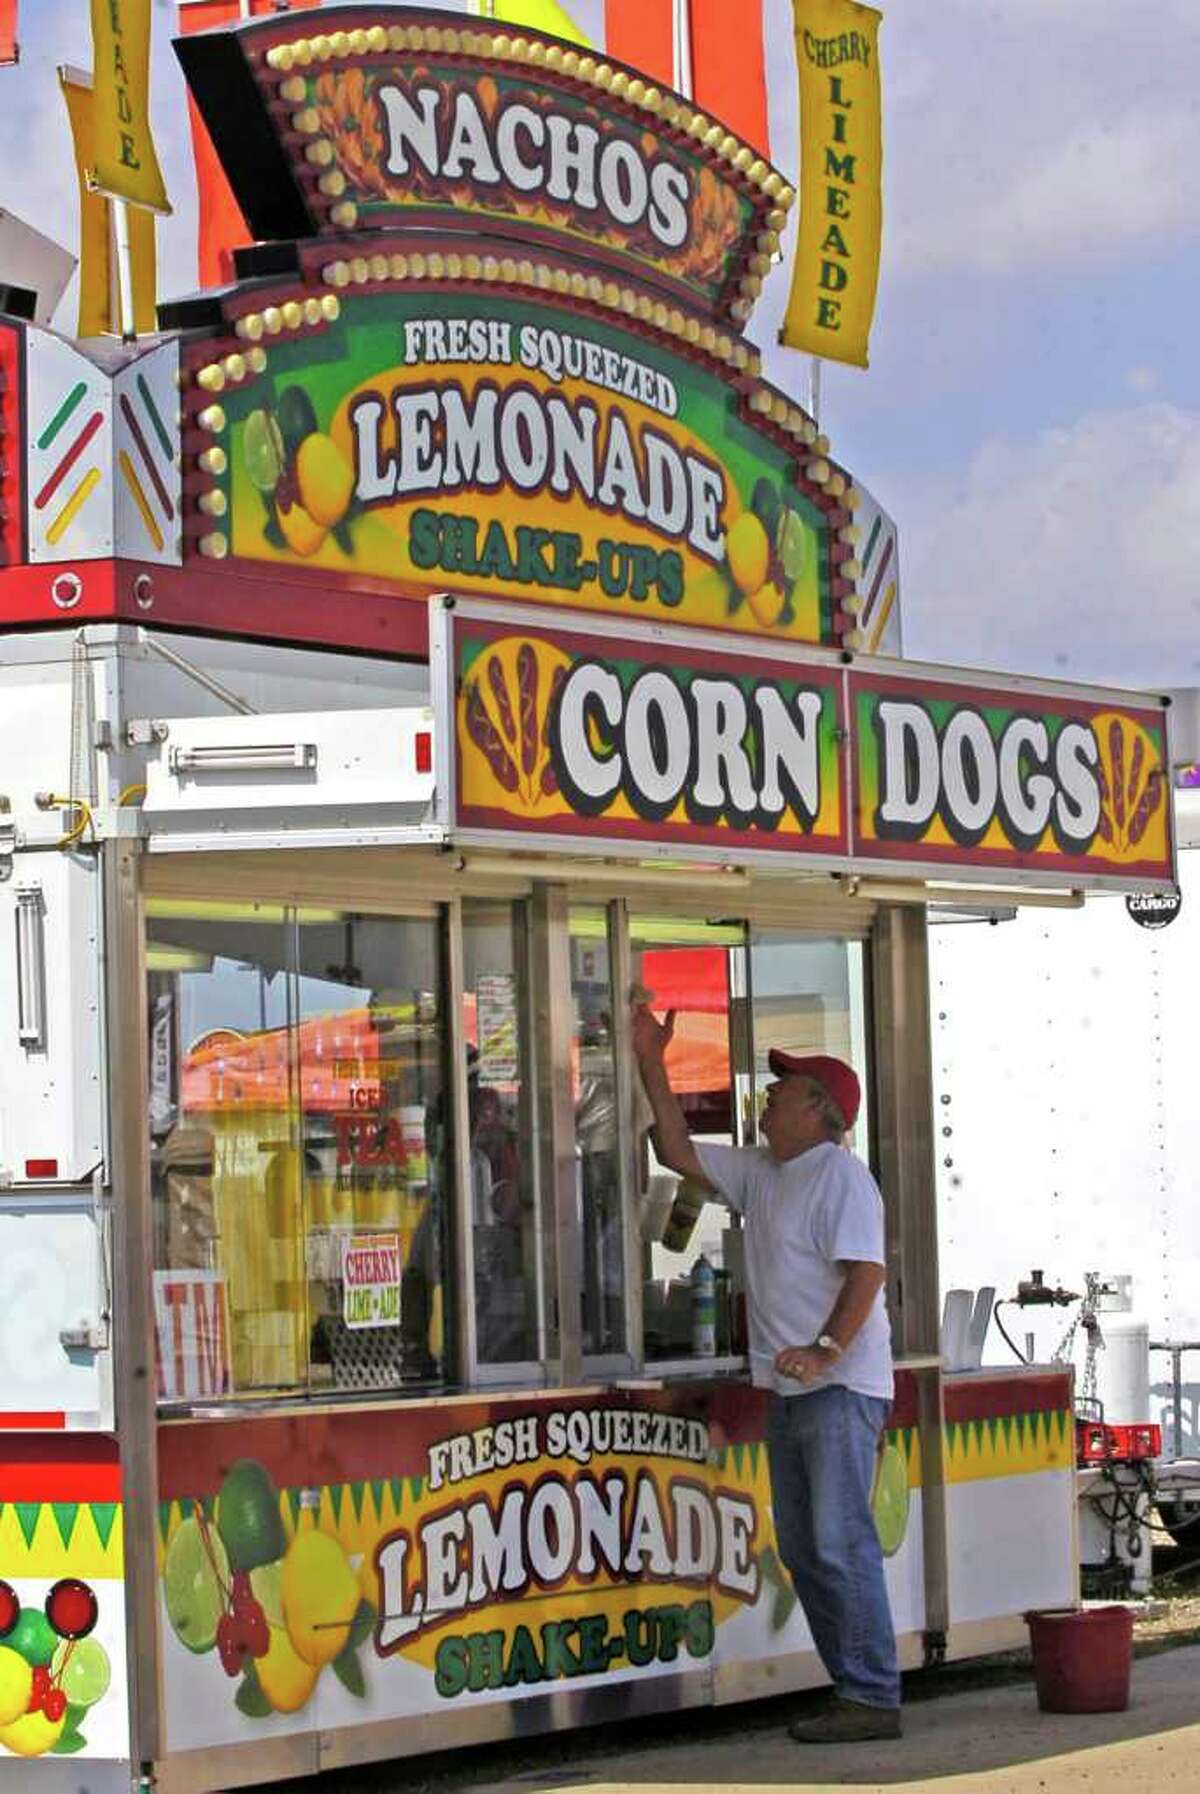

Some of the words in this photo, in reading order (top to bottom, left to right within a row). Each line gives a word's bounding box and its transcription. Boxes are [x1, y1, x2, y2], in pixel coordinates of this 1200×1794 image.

[803, 29, 870, 68] CHERRY
[379, 85, 689, 248] NACHOS
[816, 75, 856, 331] LIMEADE
[403, 319, 512, 364] FRESH
[519, 324, 678, 418] SQUEEZED
[351, 388, 727, 562] LEMONADE
[409, 509, 685, 606] SHAKE-UPS
[557, 661, 824, 823] CORN
[877, 701, 1102, 841] DOGS
[345, 1249, 399, 1285] CHERRY
[427, 1418, 538, 1490] FRESH
[547, 1410, 710, 1462] SQUEEZED
[378, 1476, 759, 1648] LEMONADE
[434, 1600, 715, 1698] SHAKE-UPS
